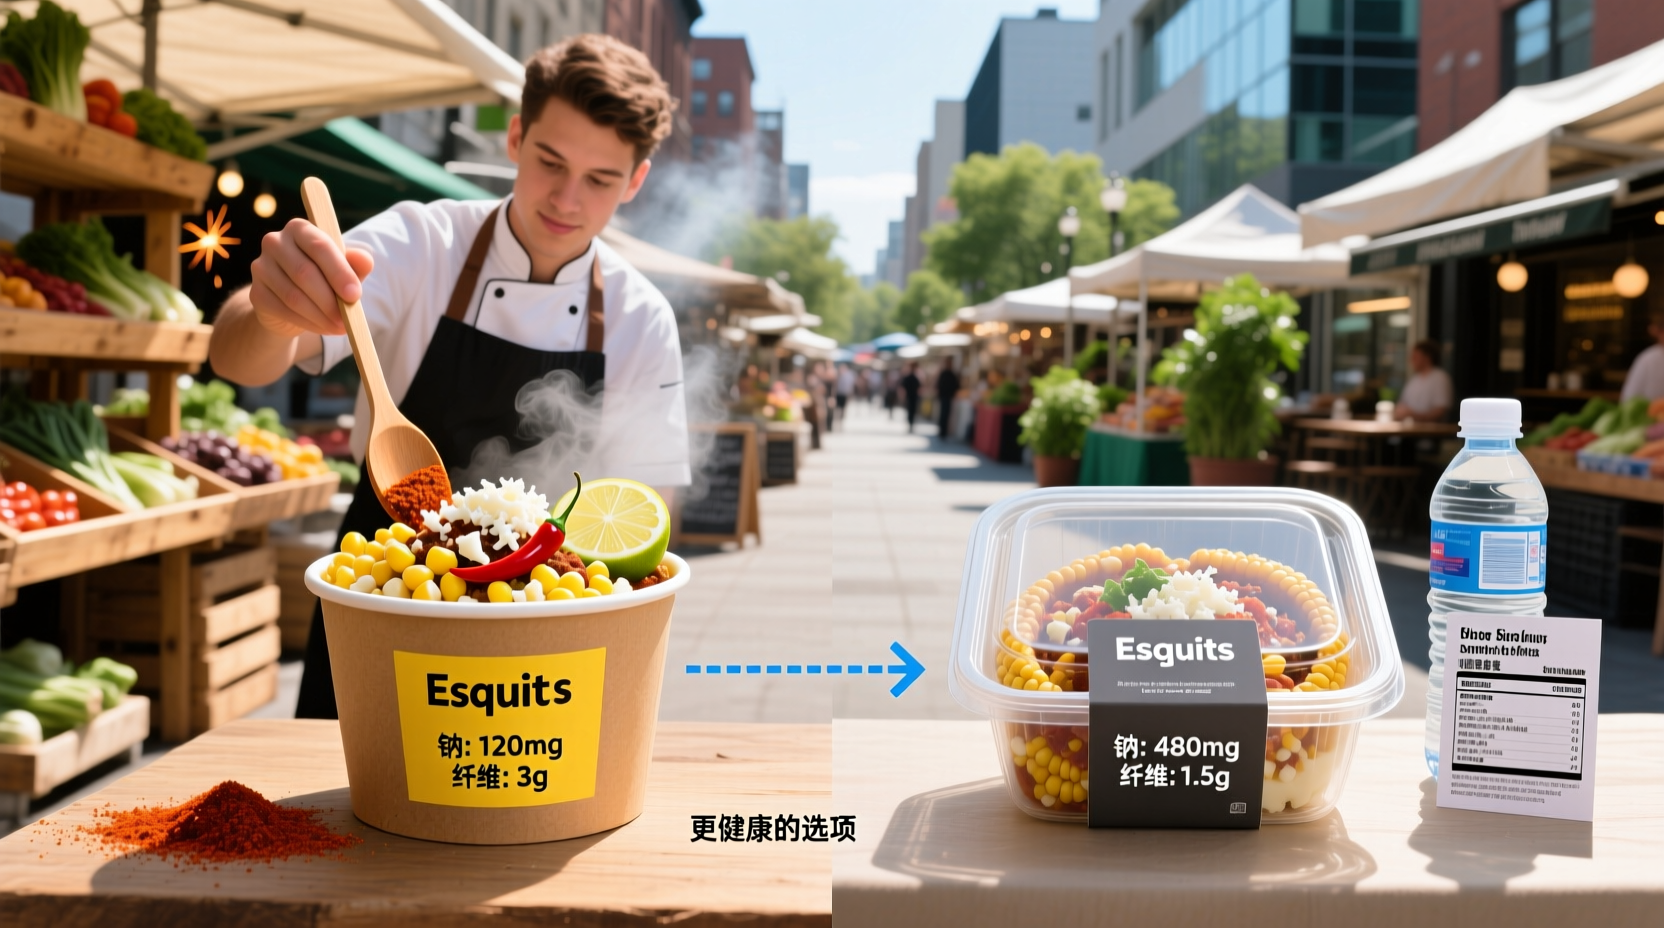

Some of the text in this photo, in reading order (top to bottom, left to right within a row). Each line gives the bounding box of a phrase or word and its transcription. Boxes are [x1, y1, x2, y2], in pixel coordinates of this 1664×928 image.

[426, 672, 572, 717] Esquits
[478, 734, 563, 761] 120mg
[1153, 735, 1240, 763] 480mg
[451, 763, 548, 793] 纤维: 3g
